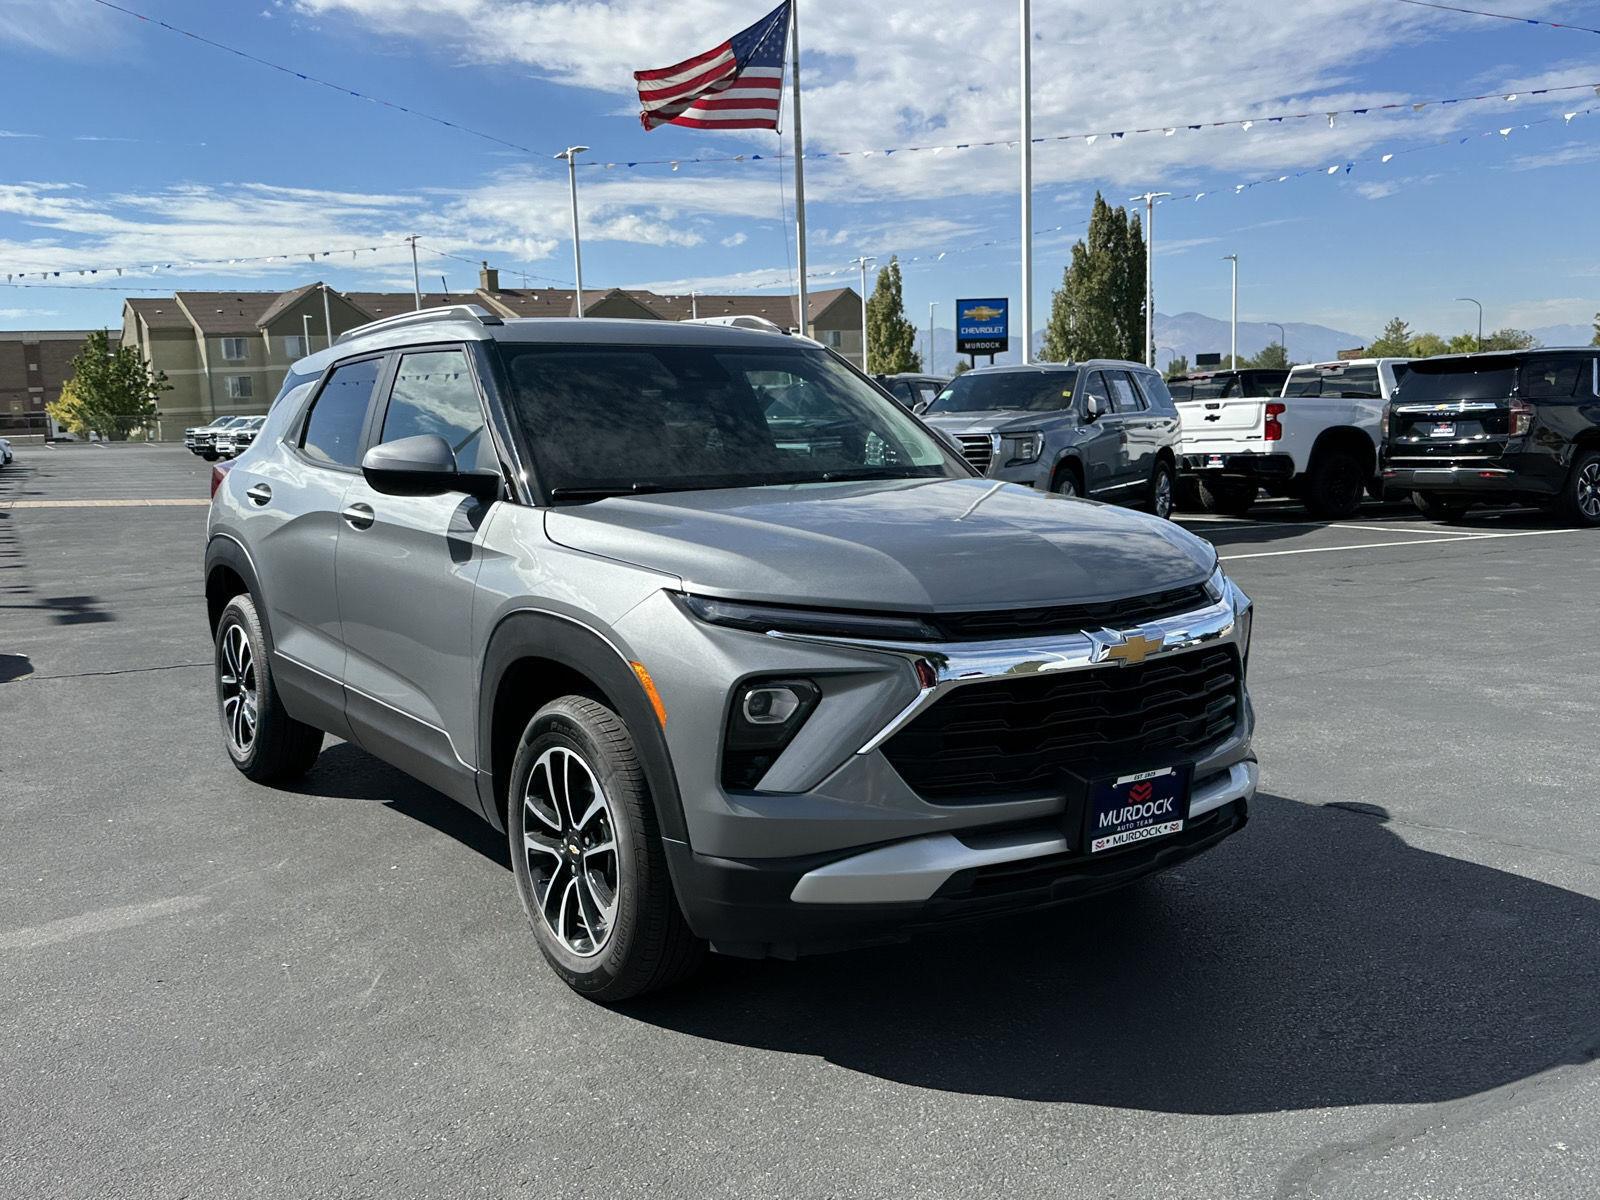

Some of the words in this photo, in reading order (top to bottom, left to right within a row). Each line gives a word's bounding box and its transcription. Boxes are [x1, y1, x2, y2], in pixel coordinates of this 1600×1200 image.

[1099, 797, 1174, 828] MURDOCK
[1117, 822, 1135, 832] AUTO
[1136, 818, 1154, 827] TEAM
[1112, 826, 1162, 845] MURDOCK
